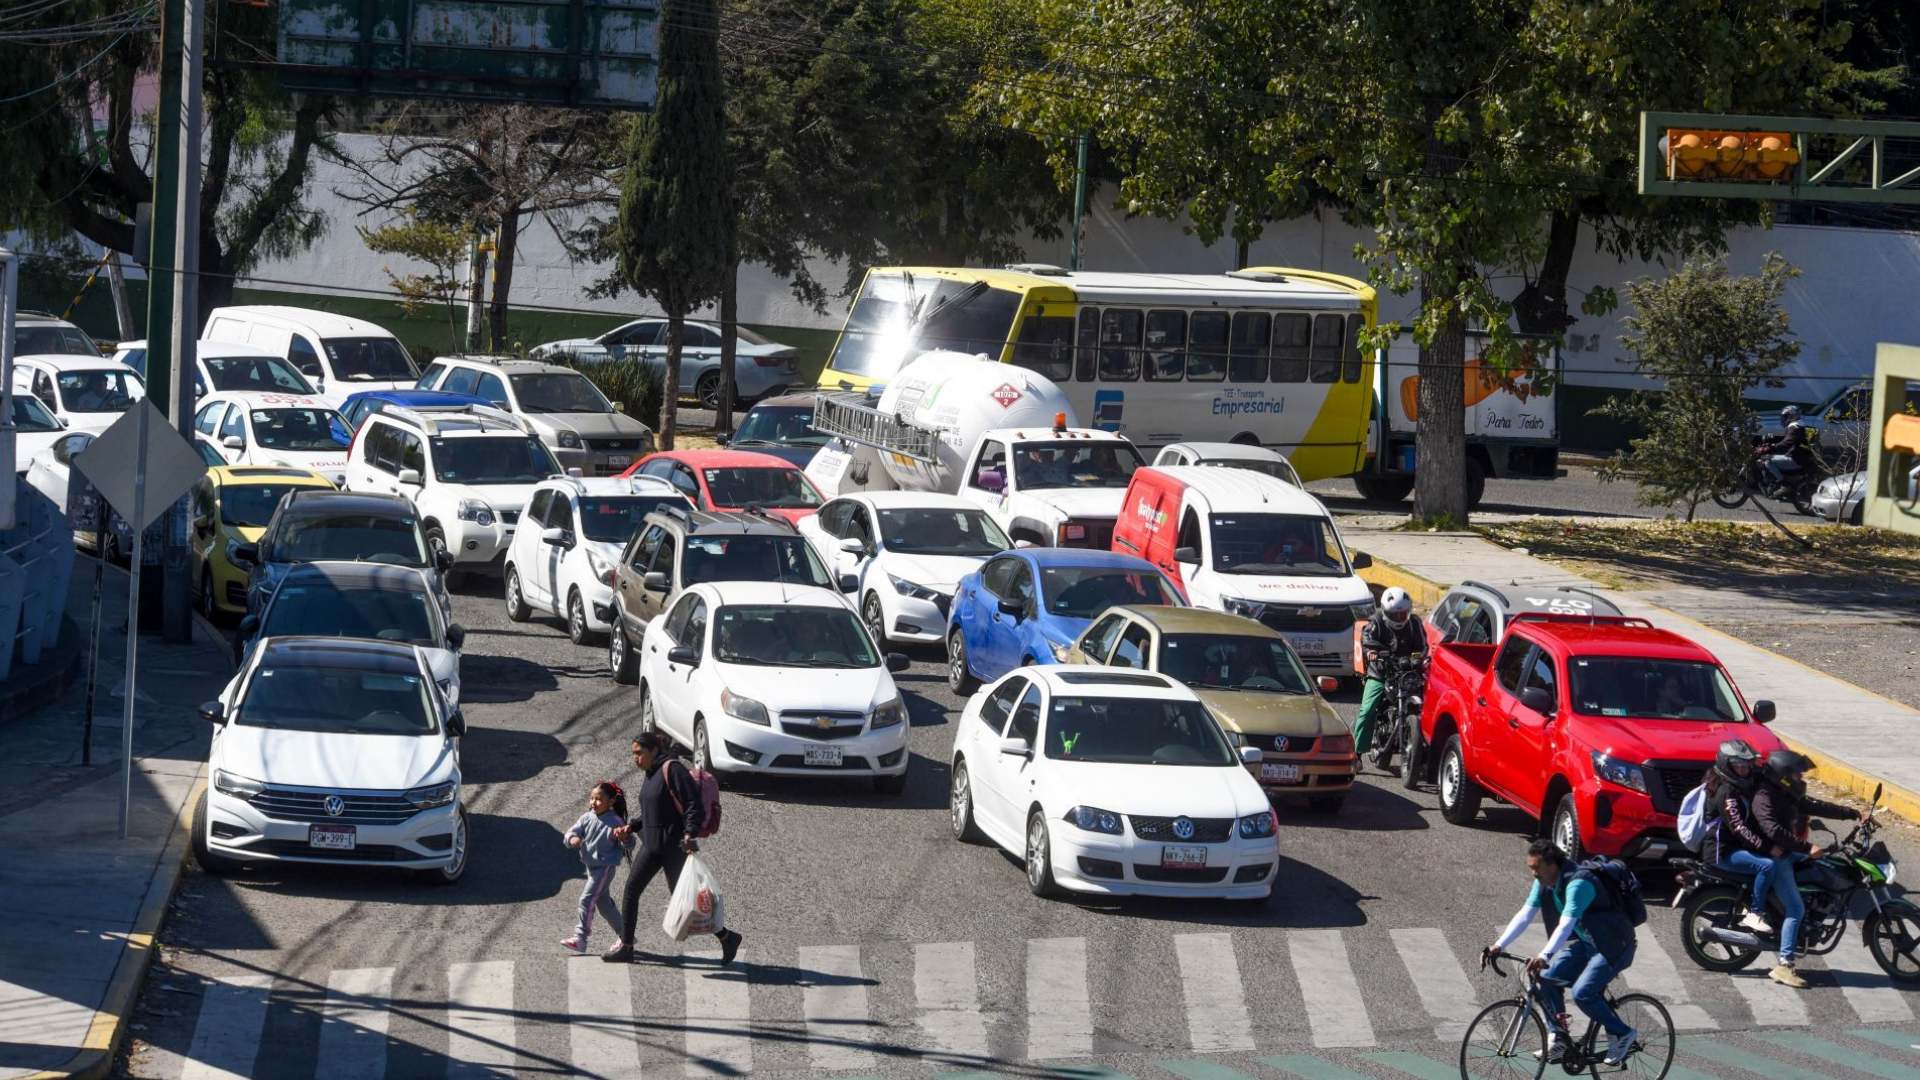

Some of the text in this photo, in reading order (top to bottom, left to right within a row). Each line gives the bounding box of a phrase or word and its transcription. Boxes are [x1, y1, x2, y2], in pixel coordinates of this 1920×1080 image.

[1212, 397, 1285, 419] Empresarial
[1486, 408, 1545, 430] Para Todos
[1286, 583, 1339, 591] deliver
